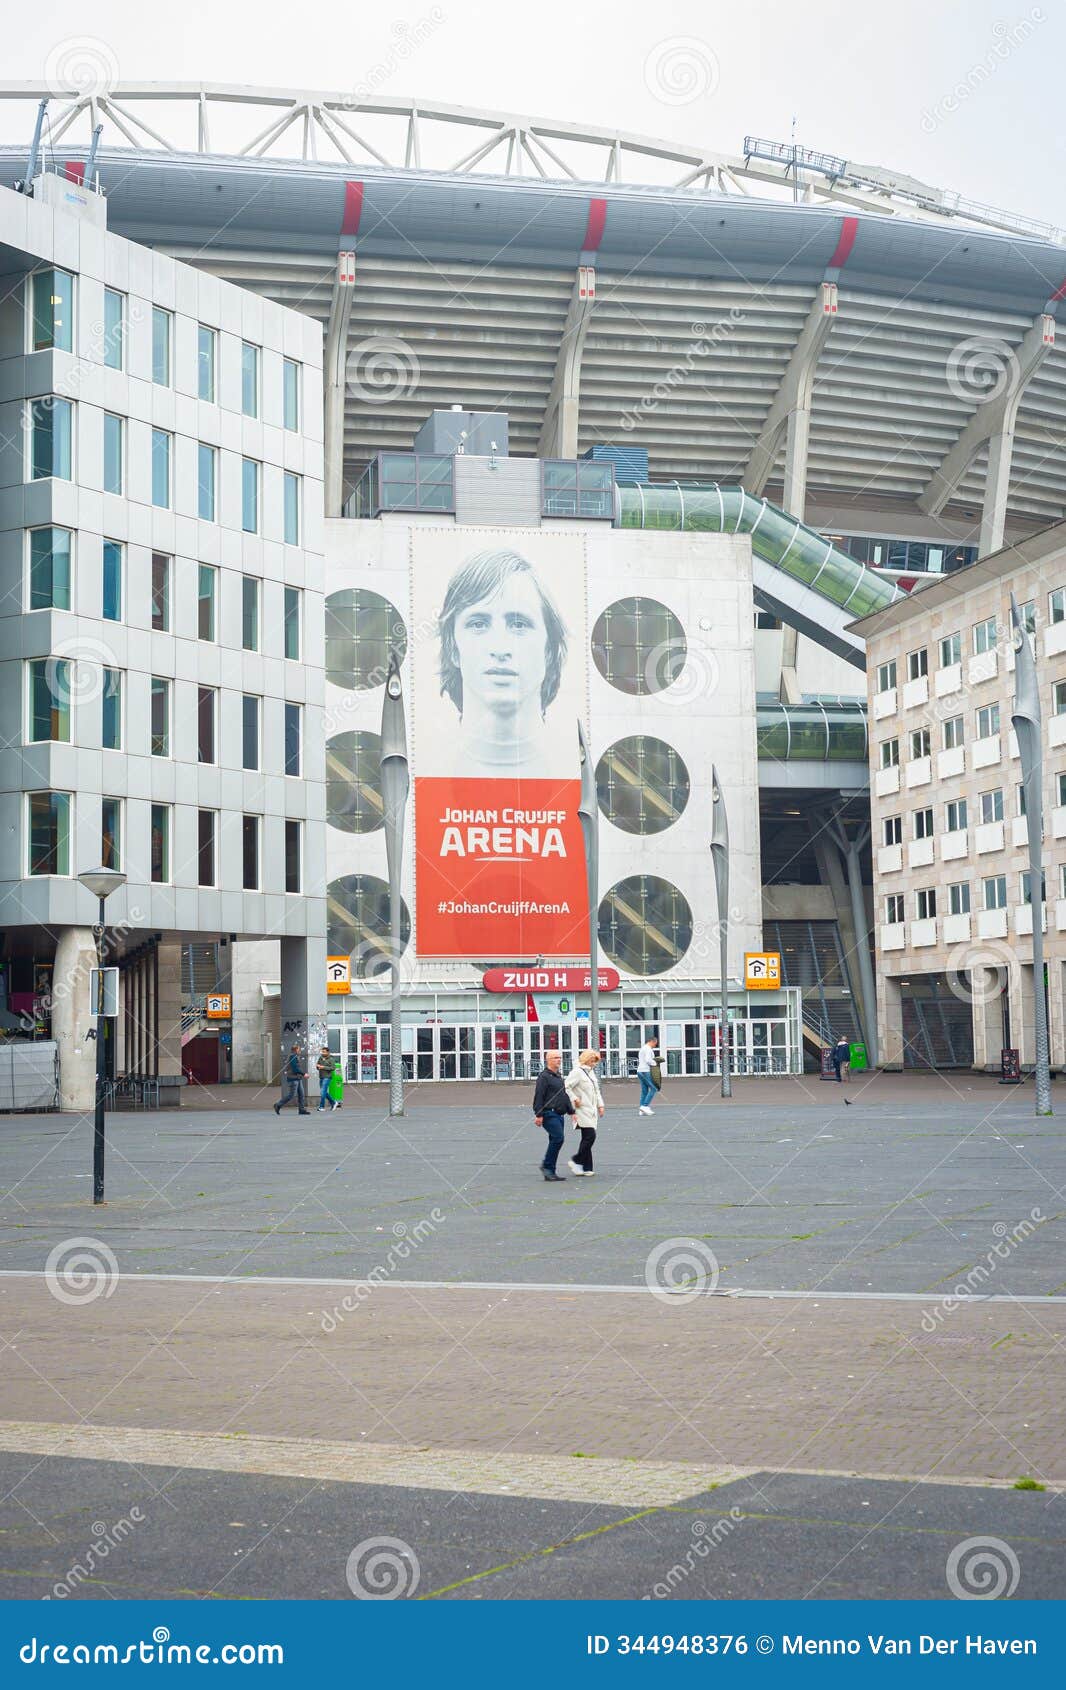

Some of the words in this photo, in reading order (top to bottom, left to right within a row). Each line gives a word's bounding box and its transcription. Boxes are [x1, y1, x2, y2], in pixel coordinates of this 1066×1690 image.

[440, 807, 498, 823] JOHAN
[439, 827, 567, 857] ARENA
[437, 901, 570, 917] #JohanCruijffArenA
[503, 973, 550, 988] ZUID
[554, 973, 568, 987] H
